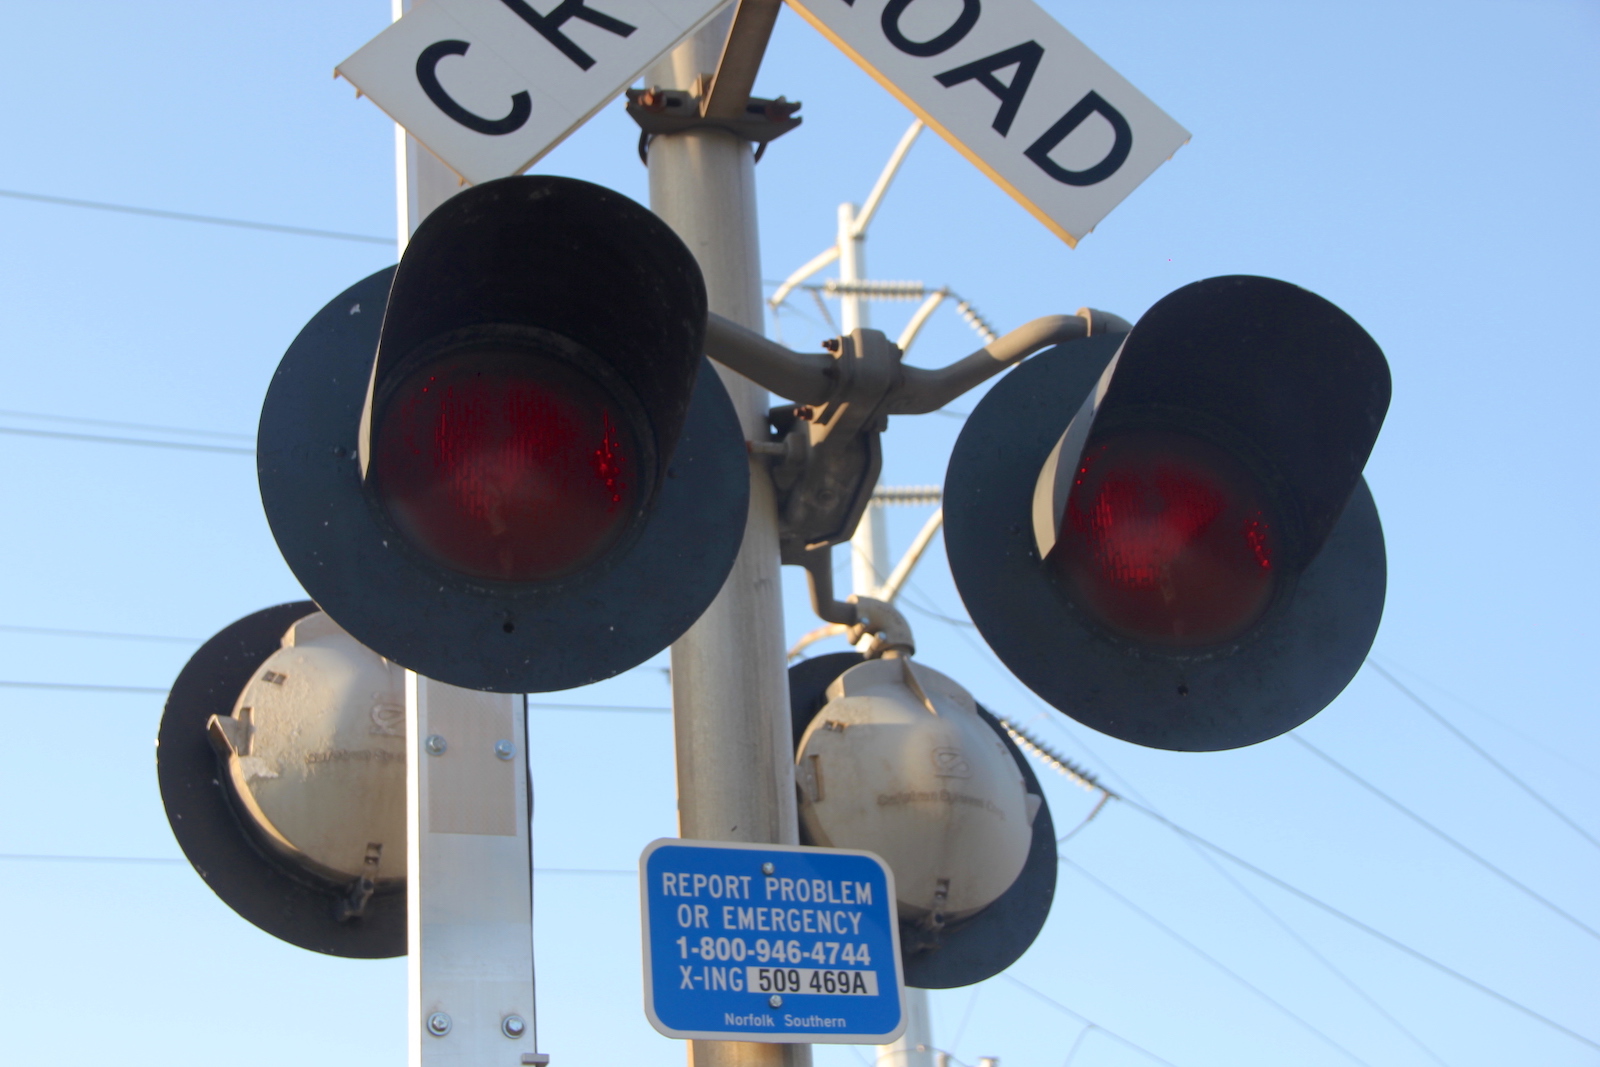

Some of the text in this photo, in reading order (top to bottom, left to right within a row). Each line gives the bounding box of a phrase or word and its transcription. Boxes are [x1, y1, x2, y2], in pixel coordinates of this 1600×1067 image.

[662, 873, 872, 905] REPORT PROBLEM
[677, 904, 862, 935] OR EMERGENCY
[676, 936, 871, 965] 1-800-946-4744
[680, 965, 867, 993] X-ING 509 469A
[725, 1013, 846, 1027] Norfolk Southern
